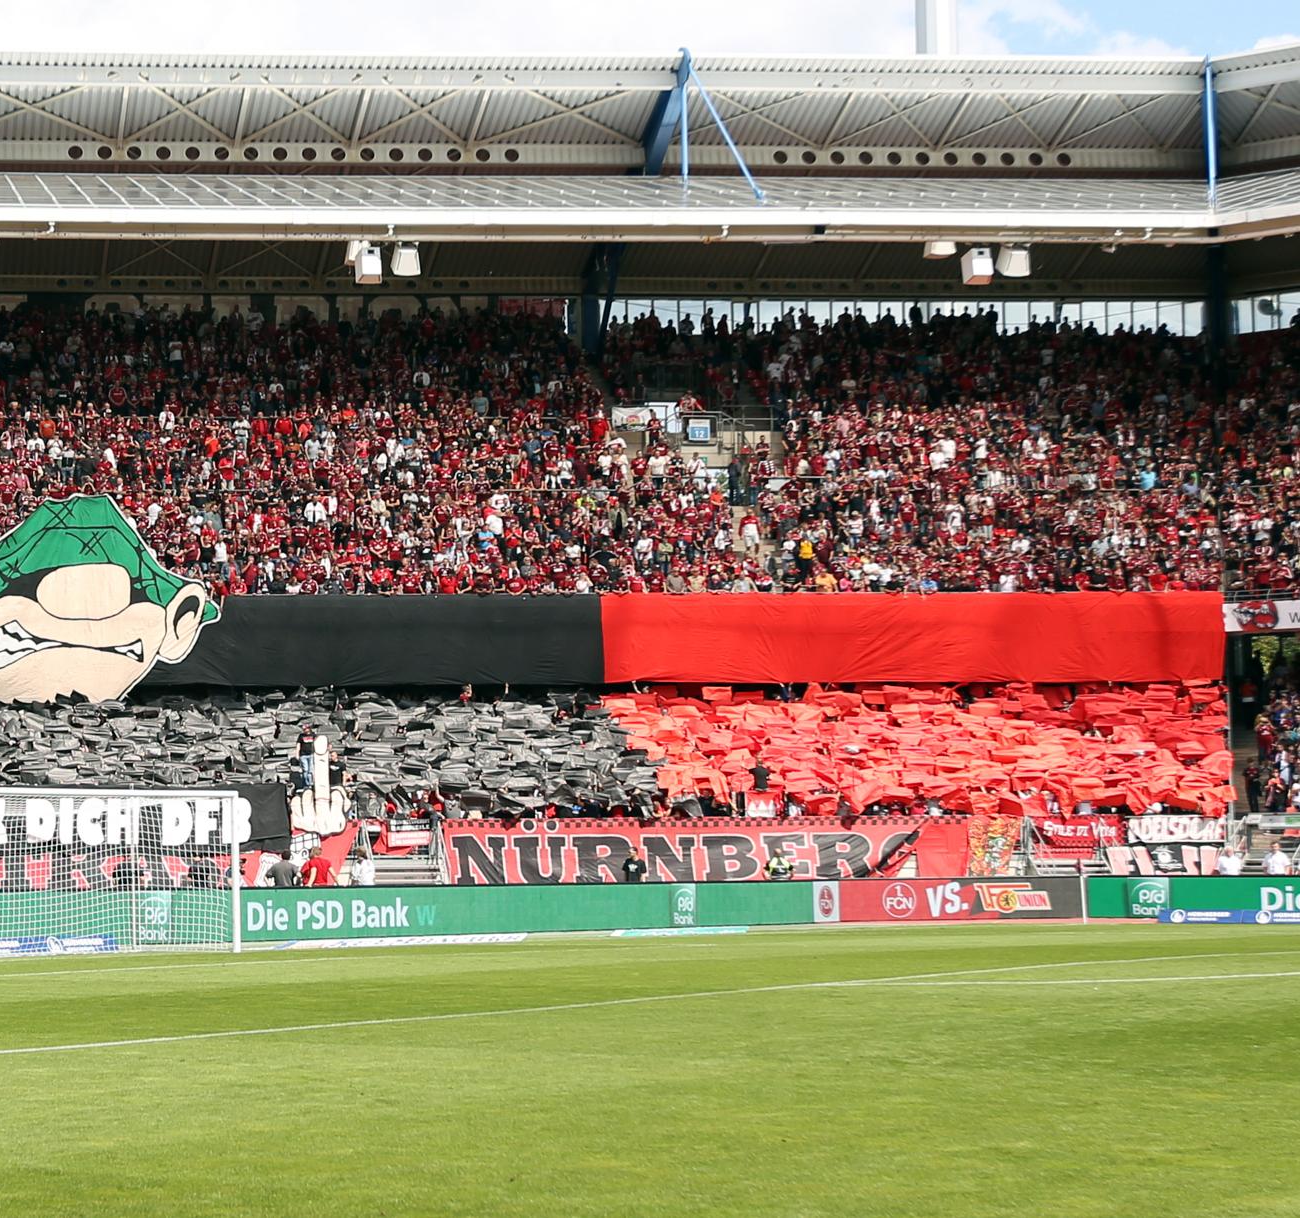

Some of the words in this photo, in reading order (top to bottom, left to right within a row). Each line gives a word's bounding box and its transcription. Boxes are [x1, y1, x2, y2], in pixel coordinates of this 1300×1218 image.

[695, 430, 705, 438] 12
[25, 797, 140, 846] DICH
[161, 797, 252, 846] DFB
[884, 897, 914, 910] FCN
[926, 881, 969, 917] VS.
[1018, 893, 1049, 907] UNION
[1138, 889, 1165, 904] psd
[246, 901, 288, 932] Die
[296, 899, 343, 931] PSD
[351, 896, 409, 928] Bank
[674, 912, 695, 925] Bank
